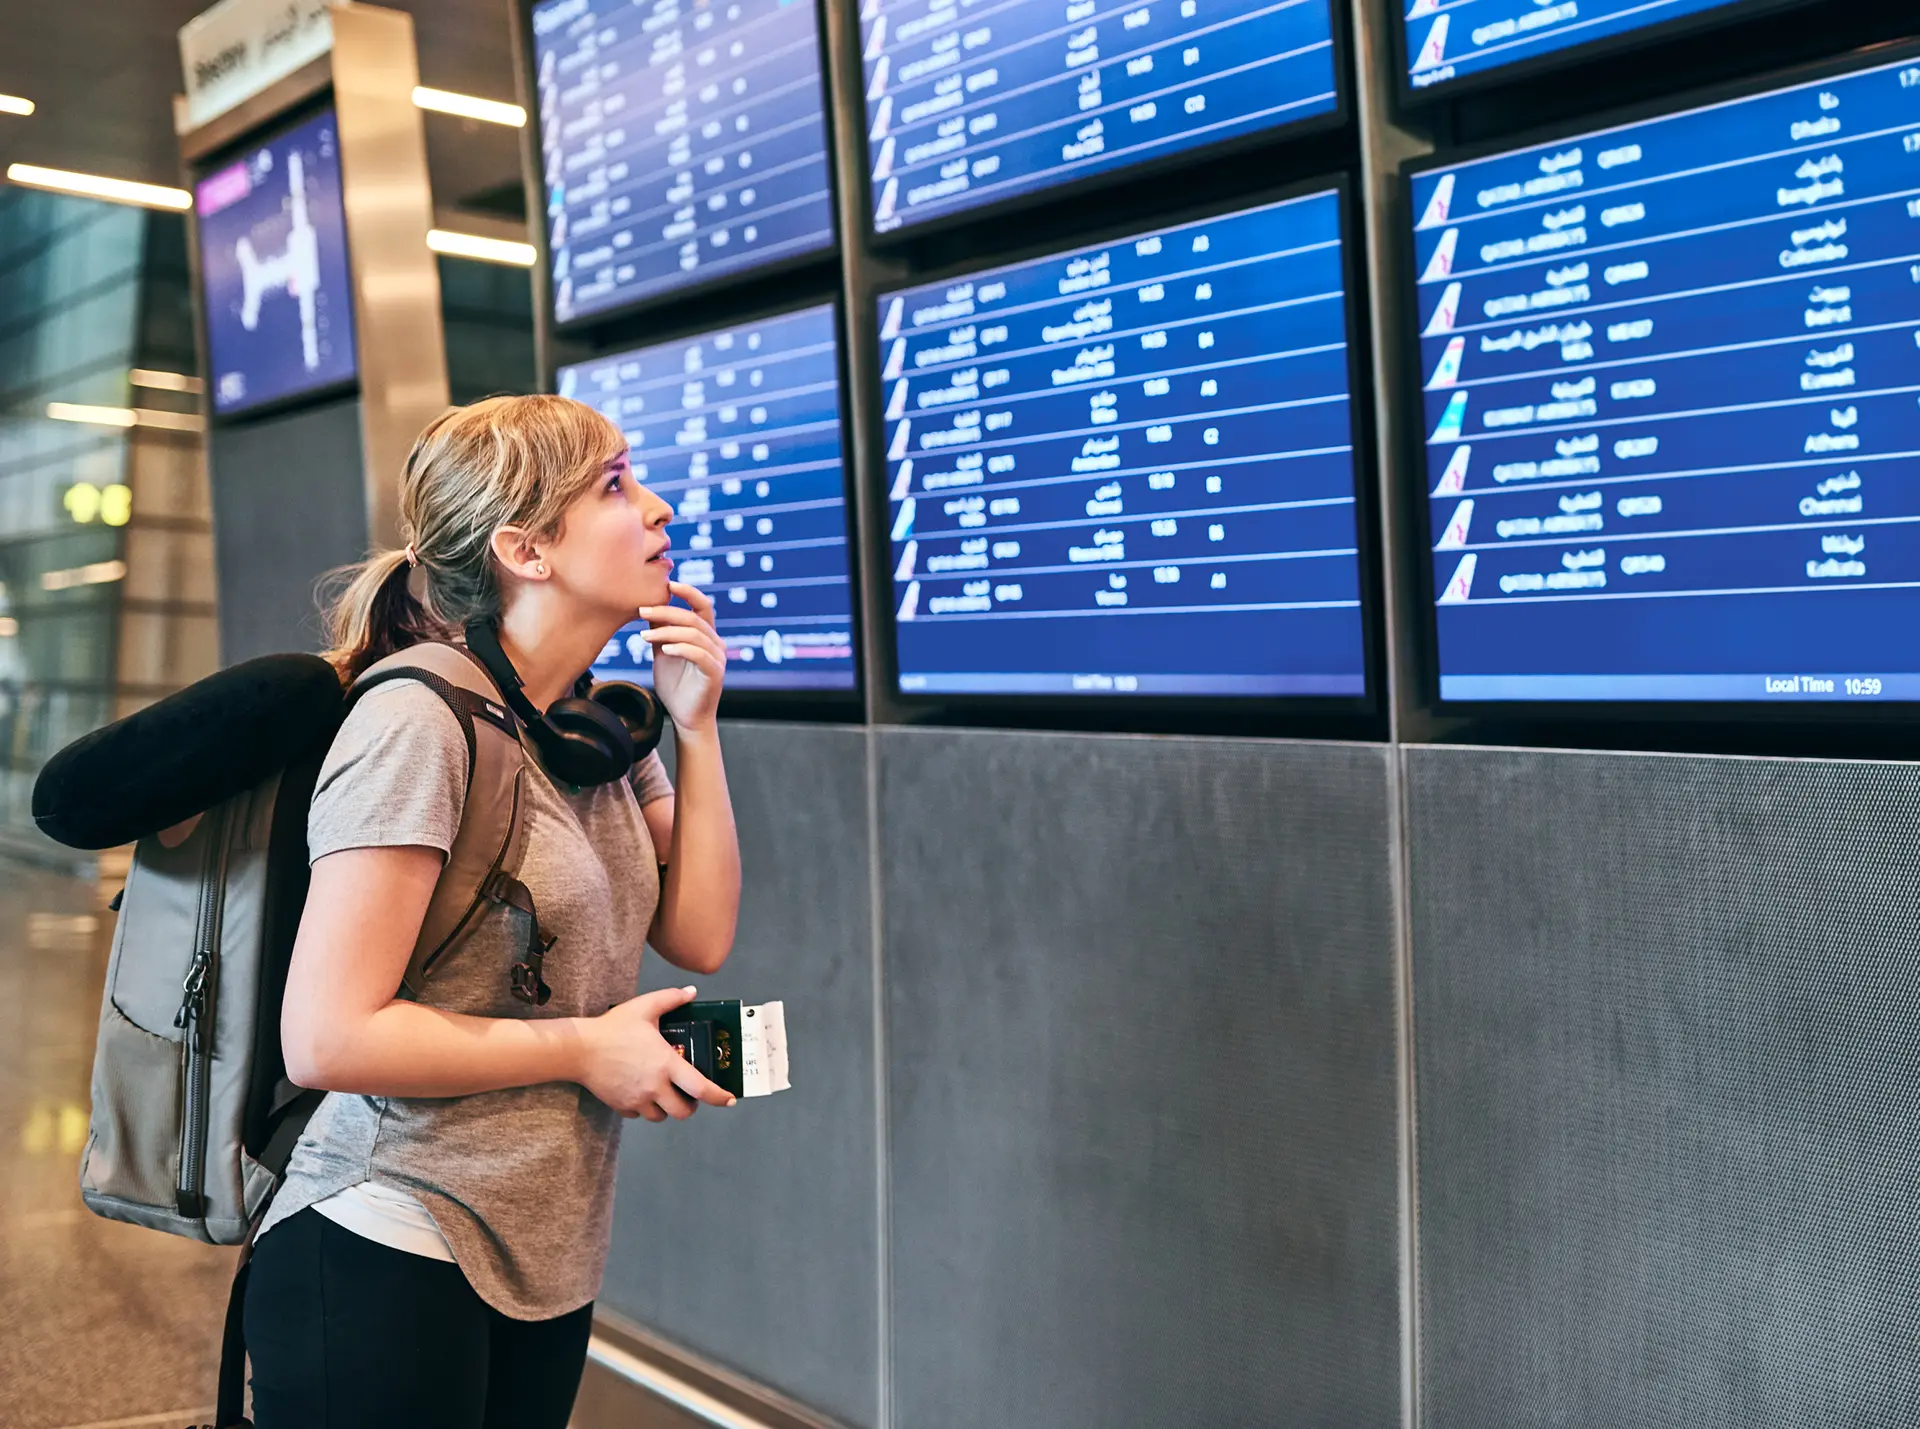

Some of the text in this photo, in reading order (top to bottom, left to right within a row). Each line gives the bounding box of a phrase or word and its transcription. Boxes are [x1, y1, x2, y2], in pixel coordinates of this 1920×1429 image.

[1765, 675, 1882, 695] Local Time 10:59
